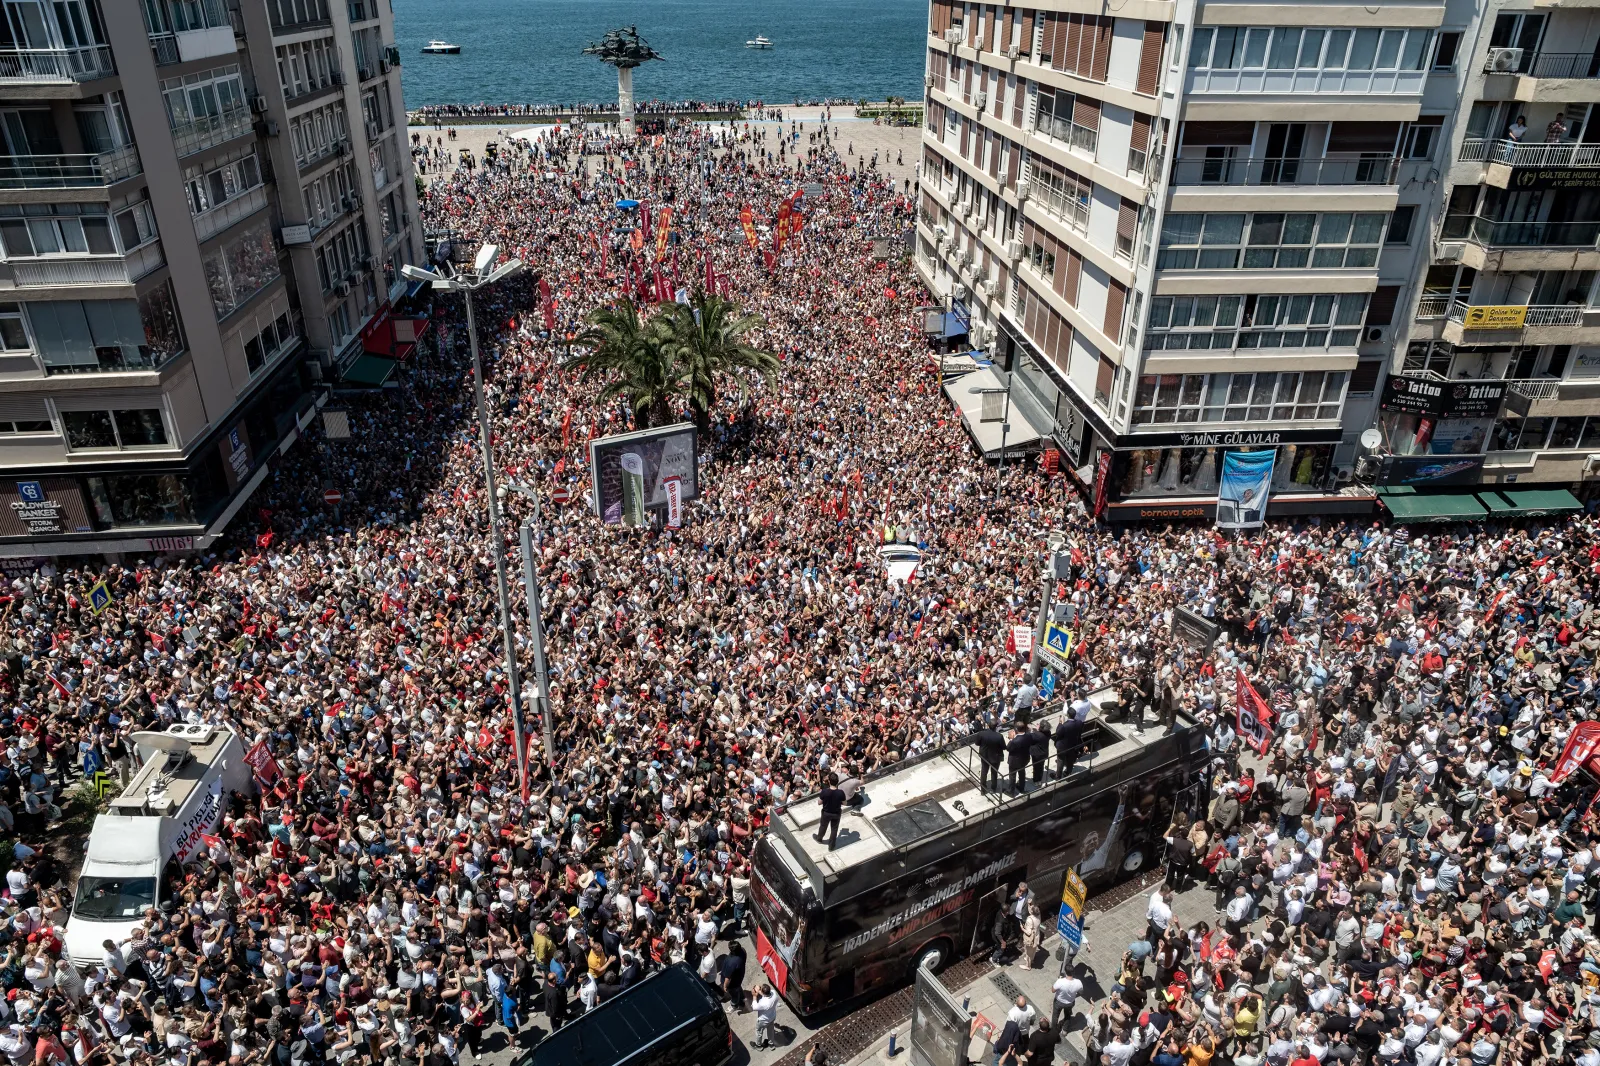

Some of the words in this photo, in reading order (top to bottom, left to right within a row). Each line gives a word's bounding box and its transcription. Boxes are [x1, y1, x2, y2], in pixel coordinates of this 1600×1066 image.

[1539, 170, 1572, 179] GÜLTEKE
[1572, 171, 1598, 179] HUKUK
[1408, 380, 1442, 397] Tattoo
[1468, 385, 1502, 399] Tattoo
[1193, 432, 1221, 445] MİNE
[1224, 431, 1280, 444] GÜLAYLAR
[10, 500, 61, 510] COLDWELL
[18, 508, 57, 518] BANKER
[1141, 509, 1179, 517] bornova
[1181, 508, 1205, 517] optik
[27, 525, 60, 533] ALSANCAK
[1037, 647, 1061, 667] Liman
[1576, 735, 1597, 747] CHP
[842, 911, 903, 955] İRADEMİZE
[904, 879, 964, 919] LİDERİMİZE
[963, 851, 1018, 890] PARTİMİZE
[888, 917, 921, 944] SAHİP
[1060, 924, 1078, 940] Bariyer
